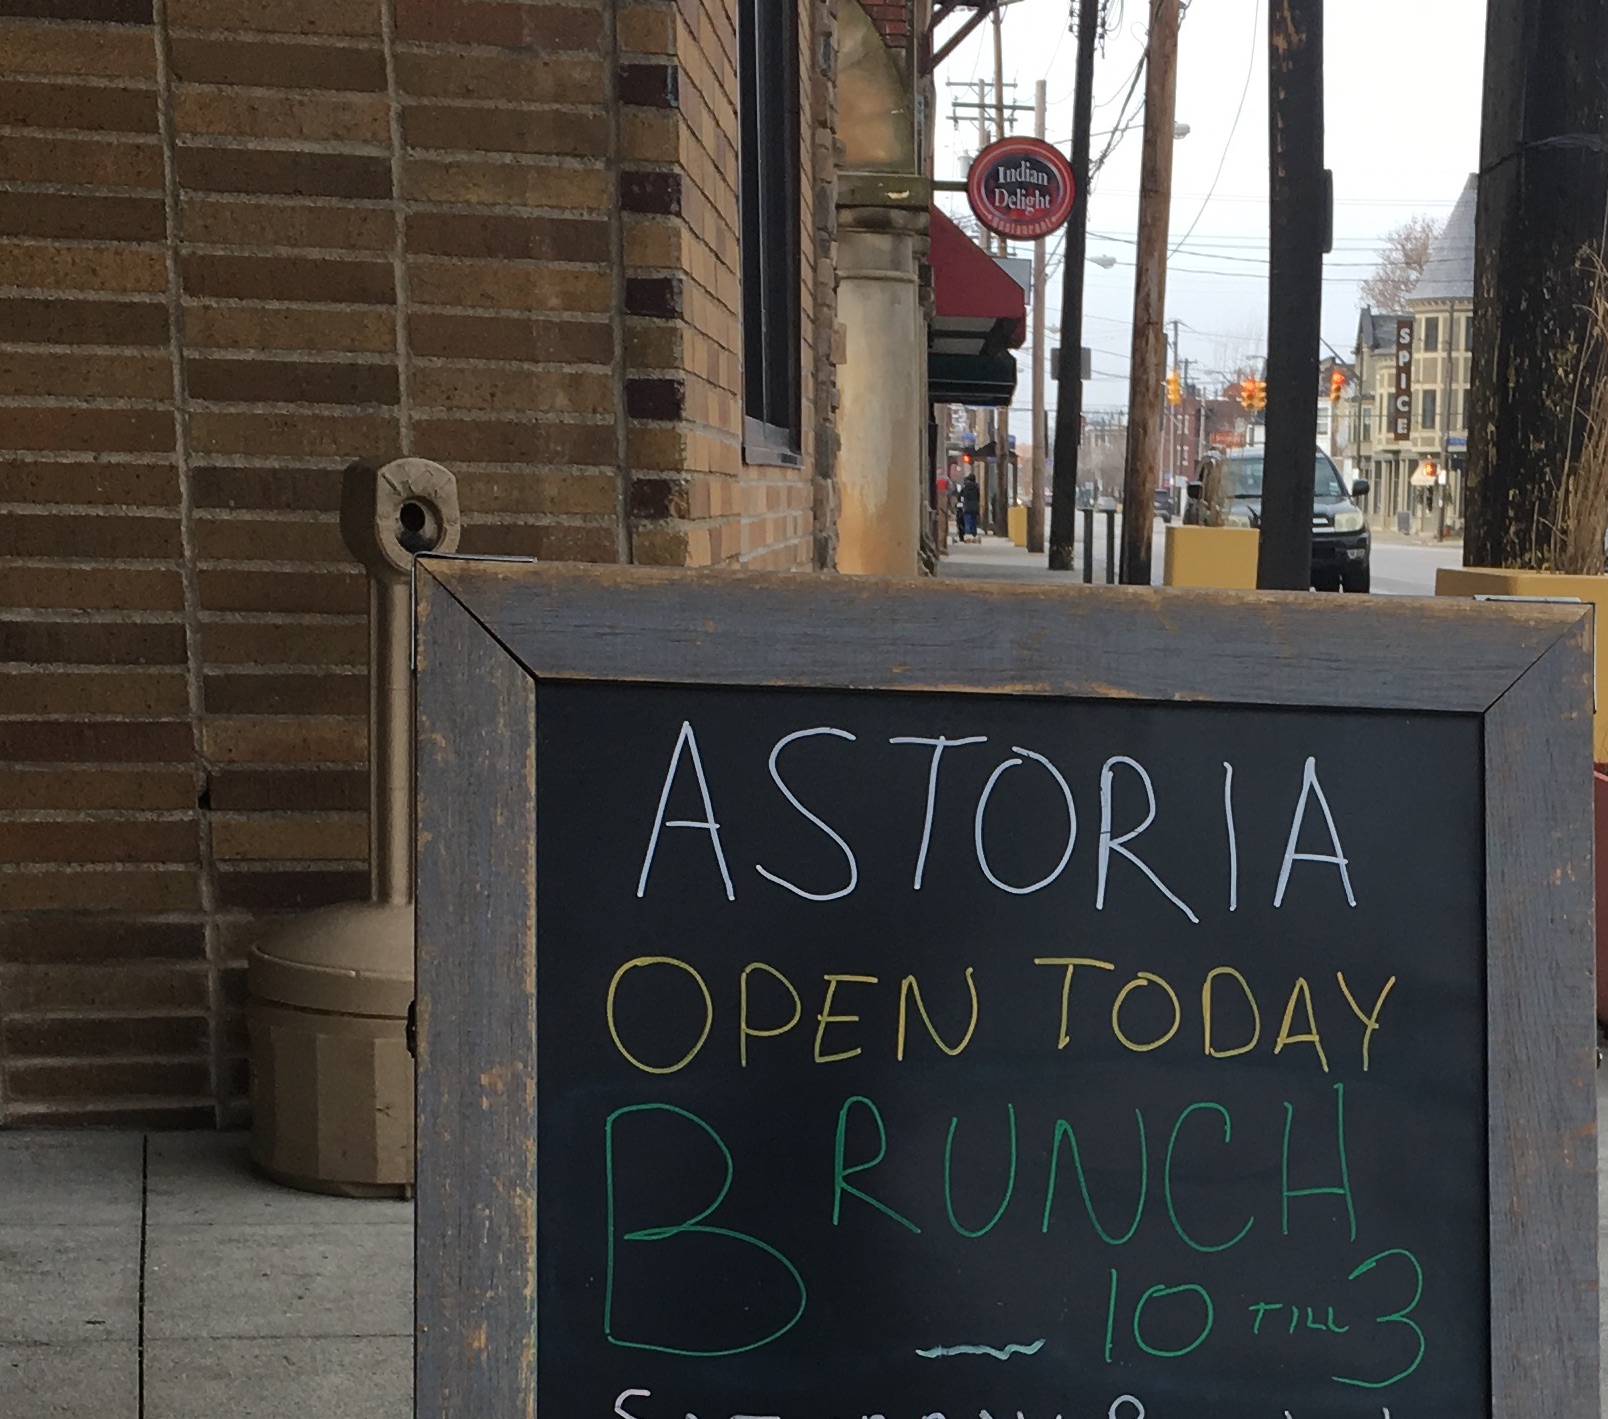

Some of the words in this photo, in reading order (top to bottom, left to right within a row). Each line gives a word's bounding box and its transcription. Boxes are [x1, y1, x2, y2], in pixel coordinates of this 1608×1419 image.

[994, 188, 1051, 216] Delight
[998, 160, 1048, 186] Indian
[1396, 327, 1411, 434] SPICE
[637, 720, 1357, 924] ASTORIA
[606, 956, 979, 1075] OPEN
[1033, 957, 1396, 1073] TODAY
[605, 1083, 1357, 1357] BRUNCH
[1105, 1268, 1214, 1363] 10
[1248, 1303, 1350, 1335] TILL
[1332, 1248, 1424, 1389] 3
